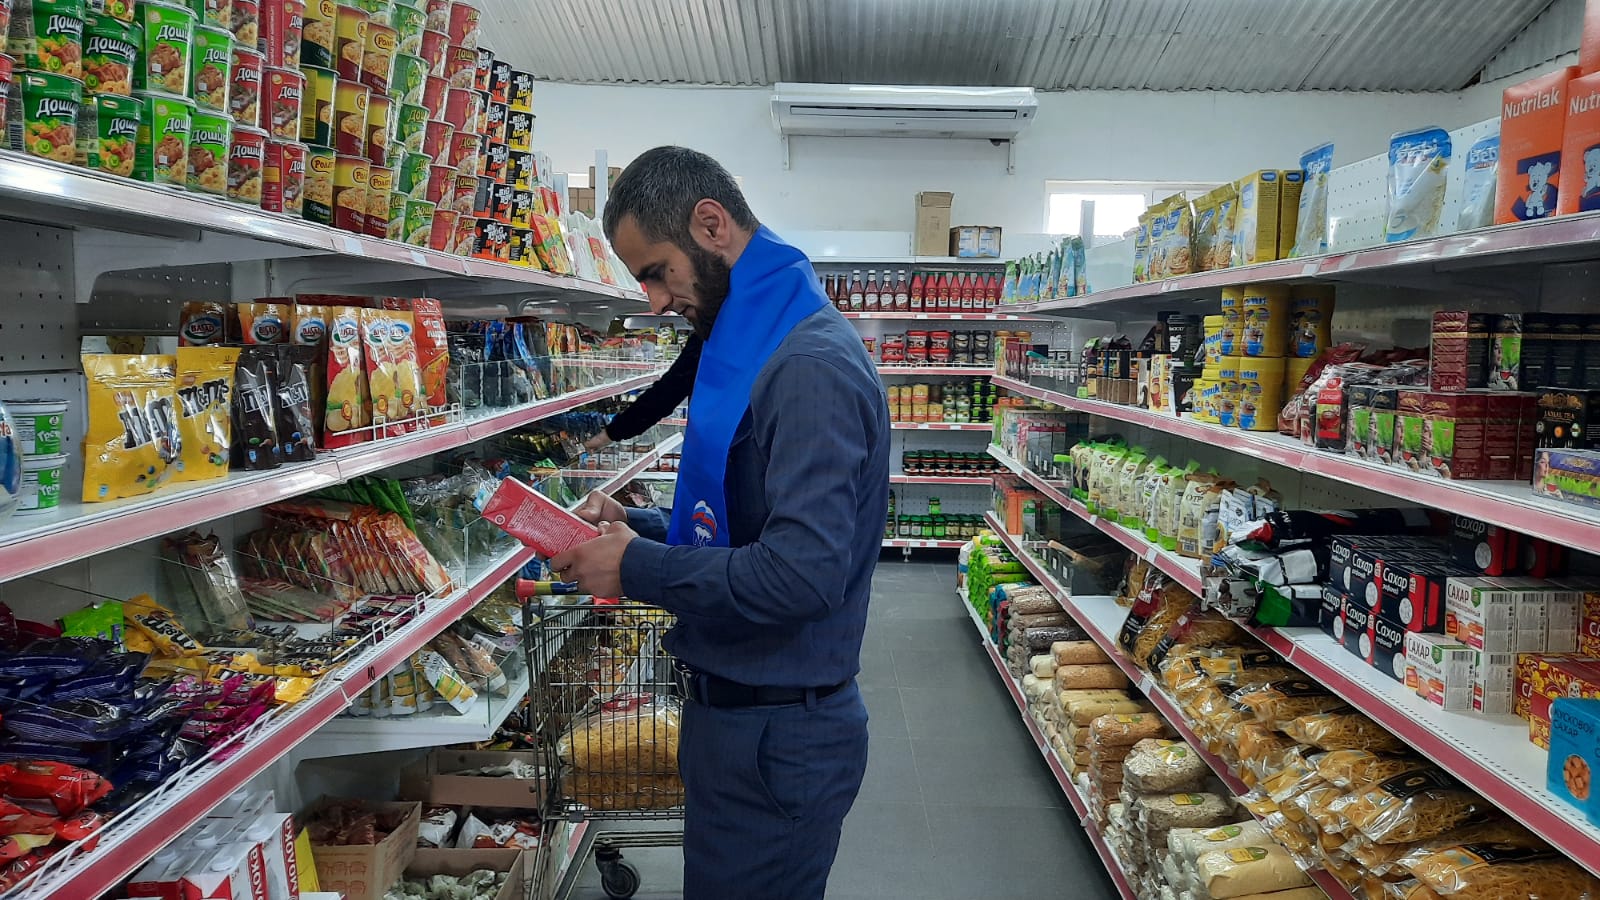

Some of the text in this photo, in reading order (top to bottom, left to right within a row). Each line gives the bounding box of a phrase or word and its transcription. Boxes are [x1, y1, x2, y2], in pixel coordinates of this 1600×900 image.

[1503, 86, 1559, 121] Nutrilak
[1454, 515, 1485, 535] Сахар
[1331, 540, 1350, 561] Сахар
[1352, 553, 1373, 576] Сахар
[1383, 567, 1408, 591] Сахар
[1322, 587, 1341, 610] Сахар
[1447, 583, 1470, 601] САХАР
[1346, 603, 1367, 628] Сахар
[1375, 620, 1402, 646] Сахар
[1408, 638, 1430, 660] САХАР
[1553, 718, 1579, 738] САХАР
